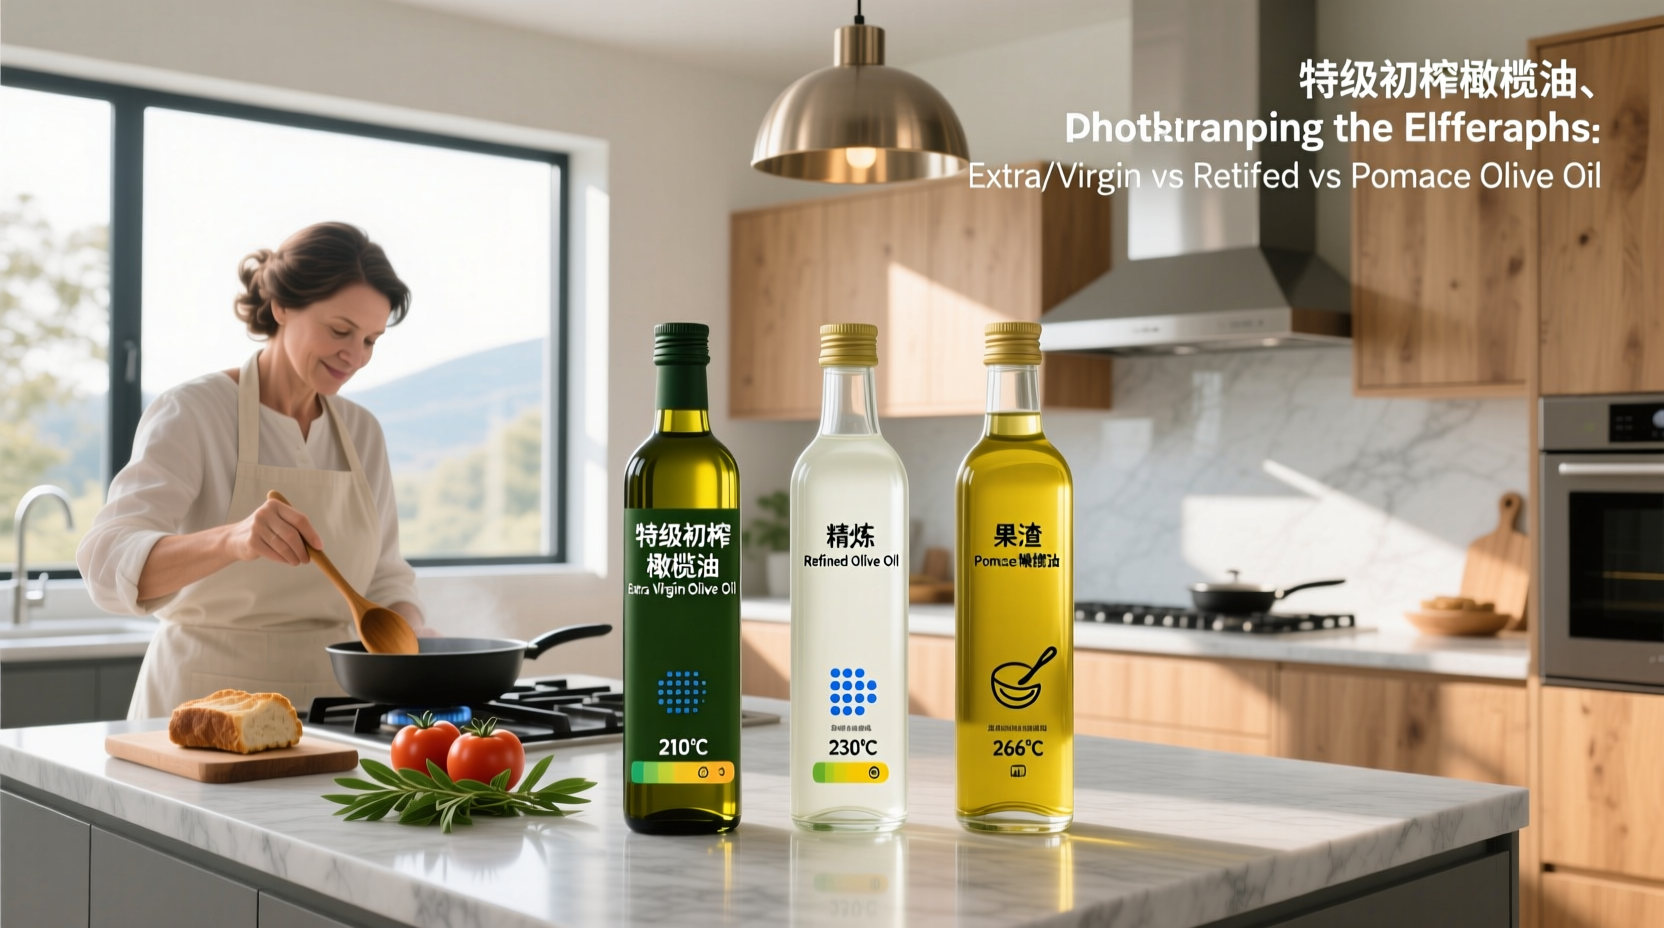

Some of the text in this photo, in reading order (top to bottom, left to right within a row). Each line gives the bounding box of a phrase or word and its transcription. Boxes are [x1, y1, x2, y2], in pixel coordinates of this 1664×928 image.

[636, 522, 731, 548] 特级初榨
[827, 522, 875, 548] 精炼
[994, 522, 1042, 548] 果渣
[646, 552, 719, 579] 橄榄油
[804, 554, 899, 567] Refined Olive Oil
[688, 581, 719, 595] Olive
[658, 738, 708, 756] 210°C
[829, 738, 877, 756] 230°C
[993, 739, 1044, 757] 266°C
